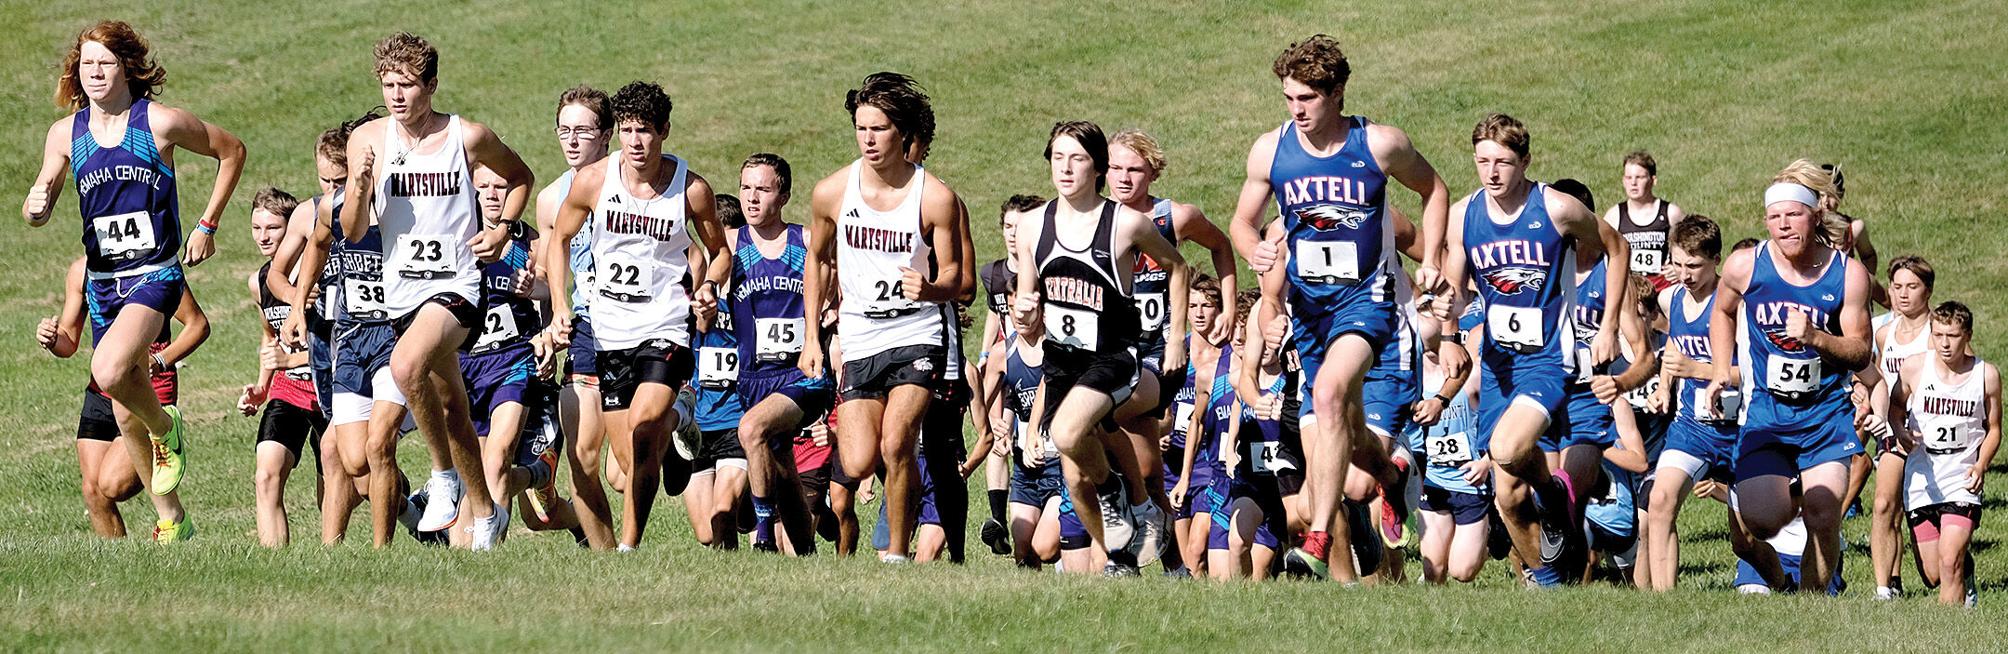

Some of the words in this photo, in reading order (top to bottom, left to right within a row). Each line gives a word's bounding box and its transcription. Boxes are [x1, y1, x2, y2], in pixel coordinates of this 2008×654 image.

[115, 164, 161, 191] CENTRAL
[391, 170, 461, 198] MARYSVILLE
[1284, 176, 1370, 207] AXTELL
[107, 217, 141, 243] 44
[606, 209, 674, 242] MARYSVILLE
[844, 223, 913, 253] MARYSVILLE
[1630, 241, 1665, 249] OUNTY
[410, 239, 443, 262] 23
[1321, 246, 1332, 267] 1
[1471, 240, 1551, 270] AXTELL
[1634, 252, 1654, 266] 48
[609, 262, 640, 286] 22
[773, 275, 804, 295] CENTR
[357, 284, 385, 304] 38
[875, 279, 906, 302] 24
[483, 312, 504, 335] 2
[767, 323, 796, 344] 45
[1061, 314, 1076, 337] 8
[1508, 312, 1521, 334] 6
[714, 351, 738, 372] 19
[1779, 362, 1811, 384] 54
[1923, 395, 1976, 418] MARYSVILLE
[1936, 426, 1957, 442] 21
[1435, 438, 1459, 456] 28
